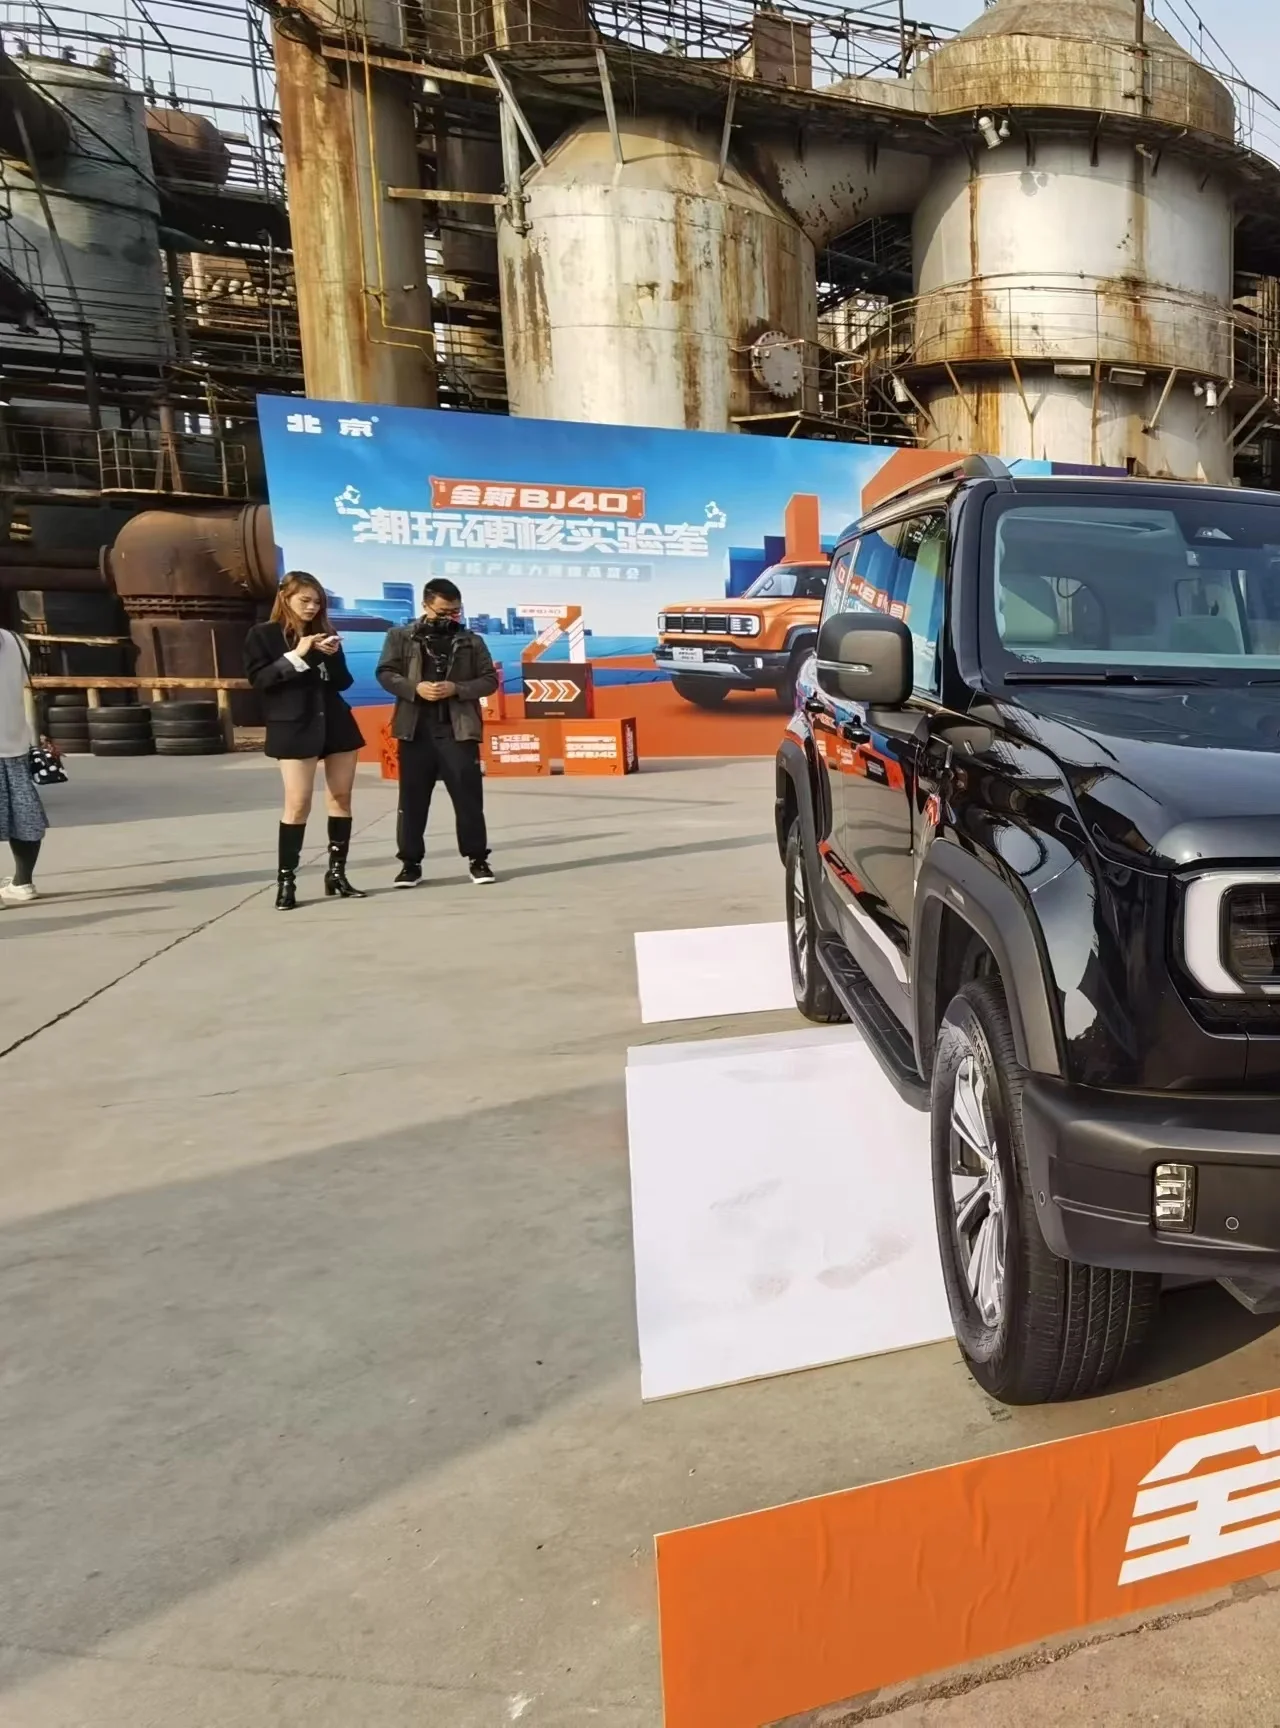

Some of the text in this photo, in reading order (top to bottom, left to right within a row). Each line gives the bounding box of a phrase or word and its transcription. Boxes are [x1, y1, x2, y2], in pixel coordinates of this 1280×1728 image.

[286, 413, 373, 437] 北京
[450, 485, 628, 513] 全新BJ40
[352, 507, 709, 557] 潮玩硬核实验室
